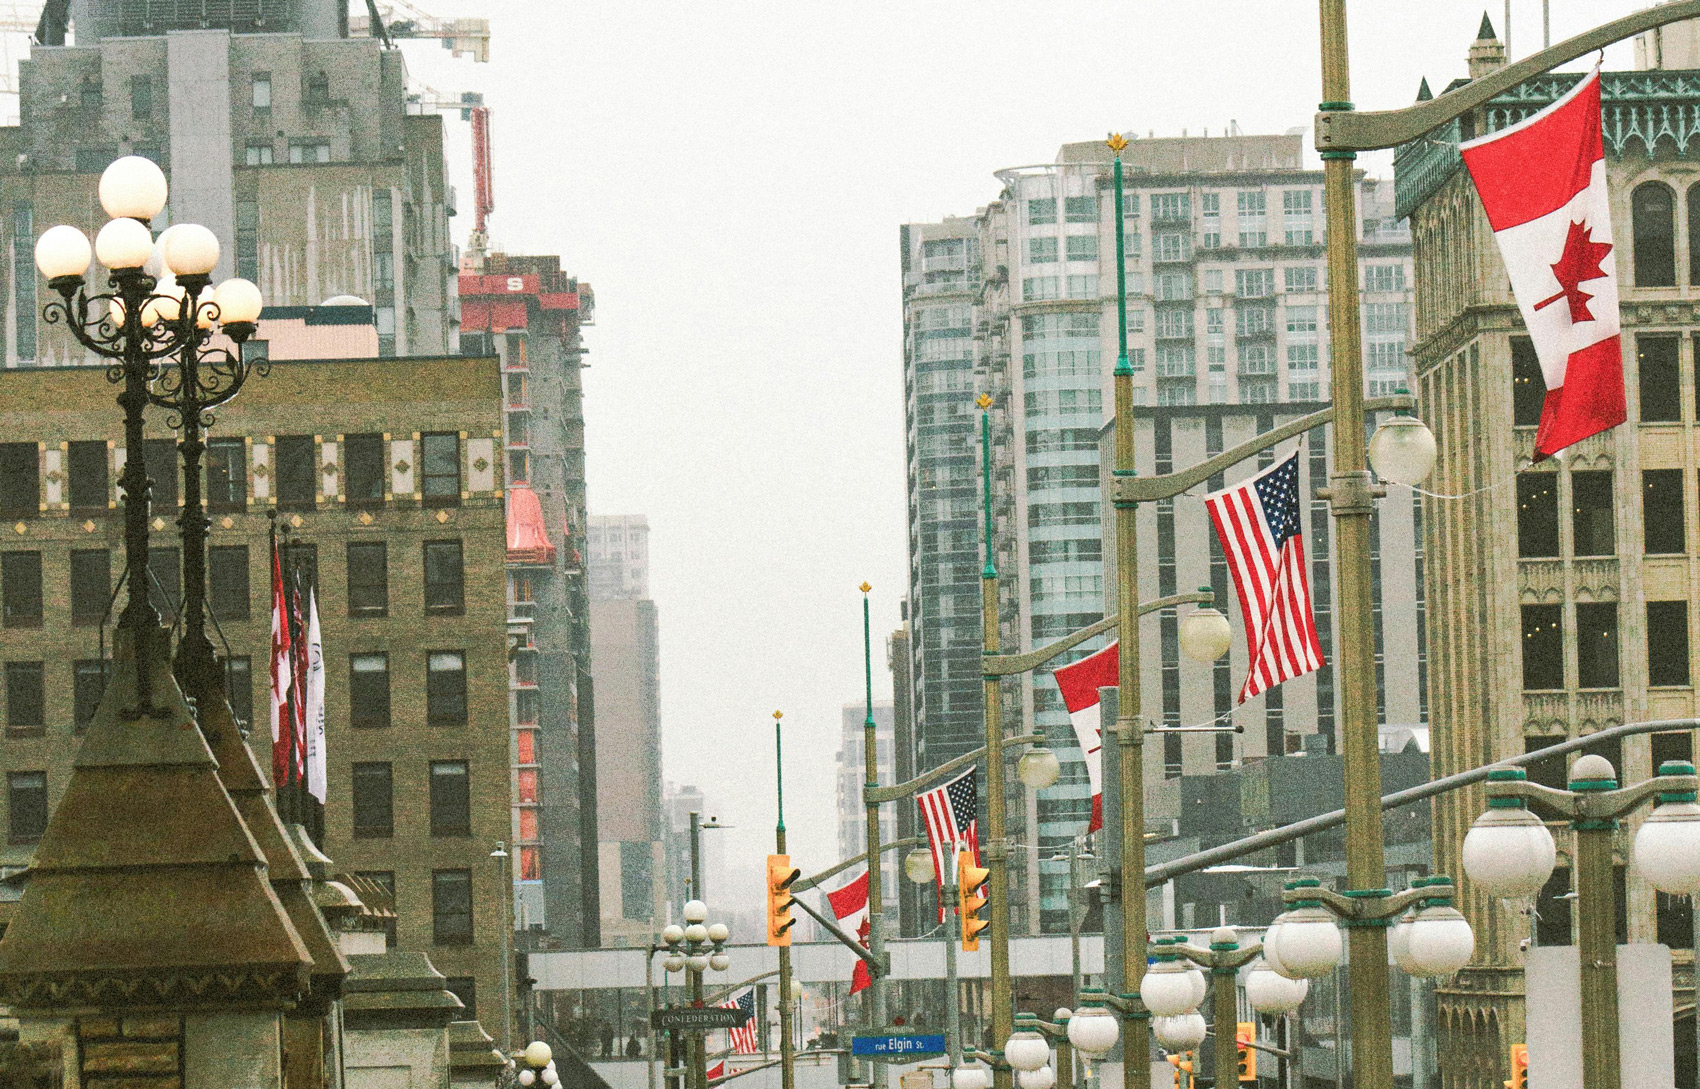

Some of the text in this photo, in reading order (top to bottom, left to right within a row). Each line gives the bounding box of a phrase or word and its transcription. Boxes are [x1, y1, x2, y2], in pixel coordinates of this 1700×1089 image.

[661, 1013, 737, 1026] CONFEDERATION
[875, 1037, 925, 1052] rue Elgin St.
